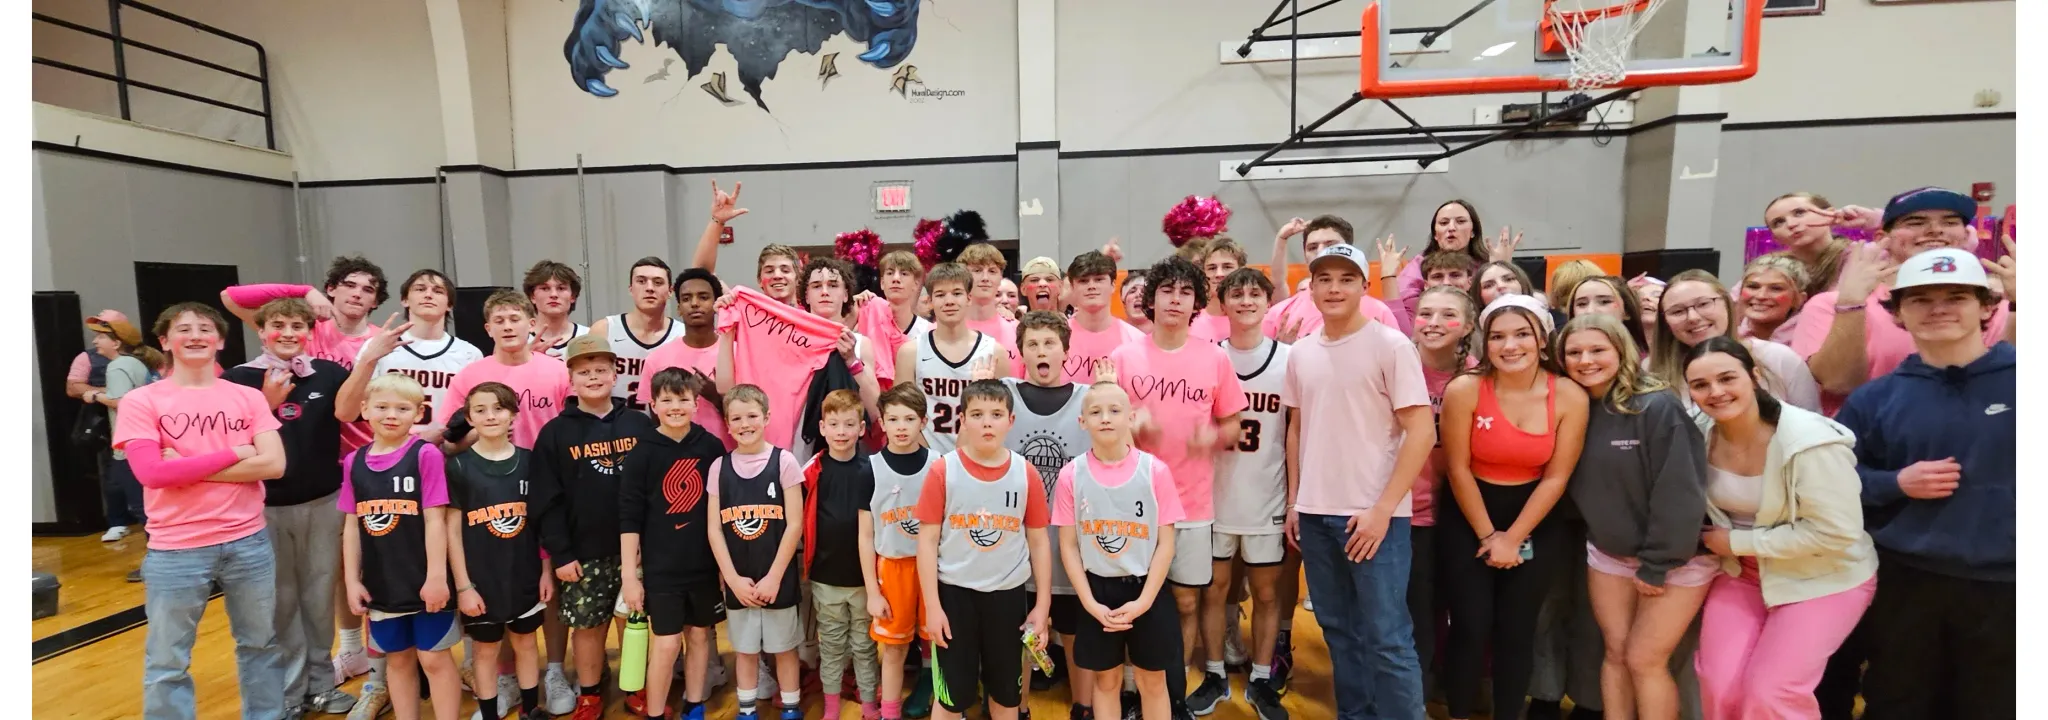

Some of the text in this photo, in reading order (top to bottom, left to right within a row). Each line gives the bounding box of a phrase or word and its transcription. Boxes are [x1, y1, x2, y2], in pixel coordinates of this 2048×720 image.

[766, 316, 811, 348] Mia
[616, 357, 645, 376] SH
[1155, 377, 1208, 403] Mia
[191, 411, 250, 436] Mia
[393, 476, 415, 493] 10
[519, 480, 528, 495] 11
[767, 482, 776, 498] 4
[1006, 491, 1018, 508] 11
[721, 505, 783, 524] PANTHER
[1135, 501, 1144, 517] 3
[950, 514, 1021, 532] PANTHER
